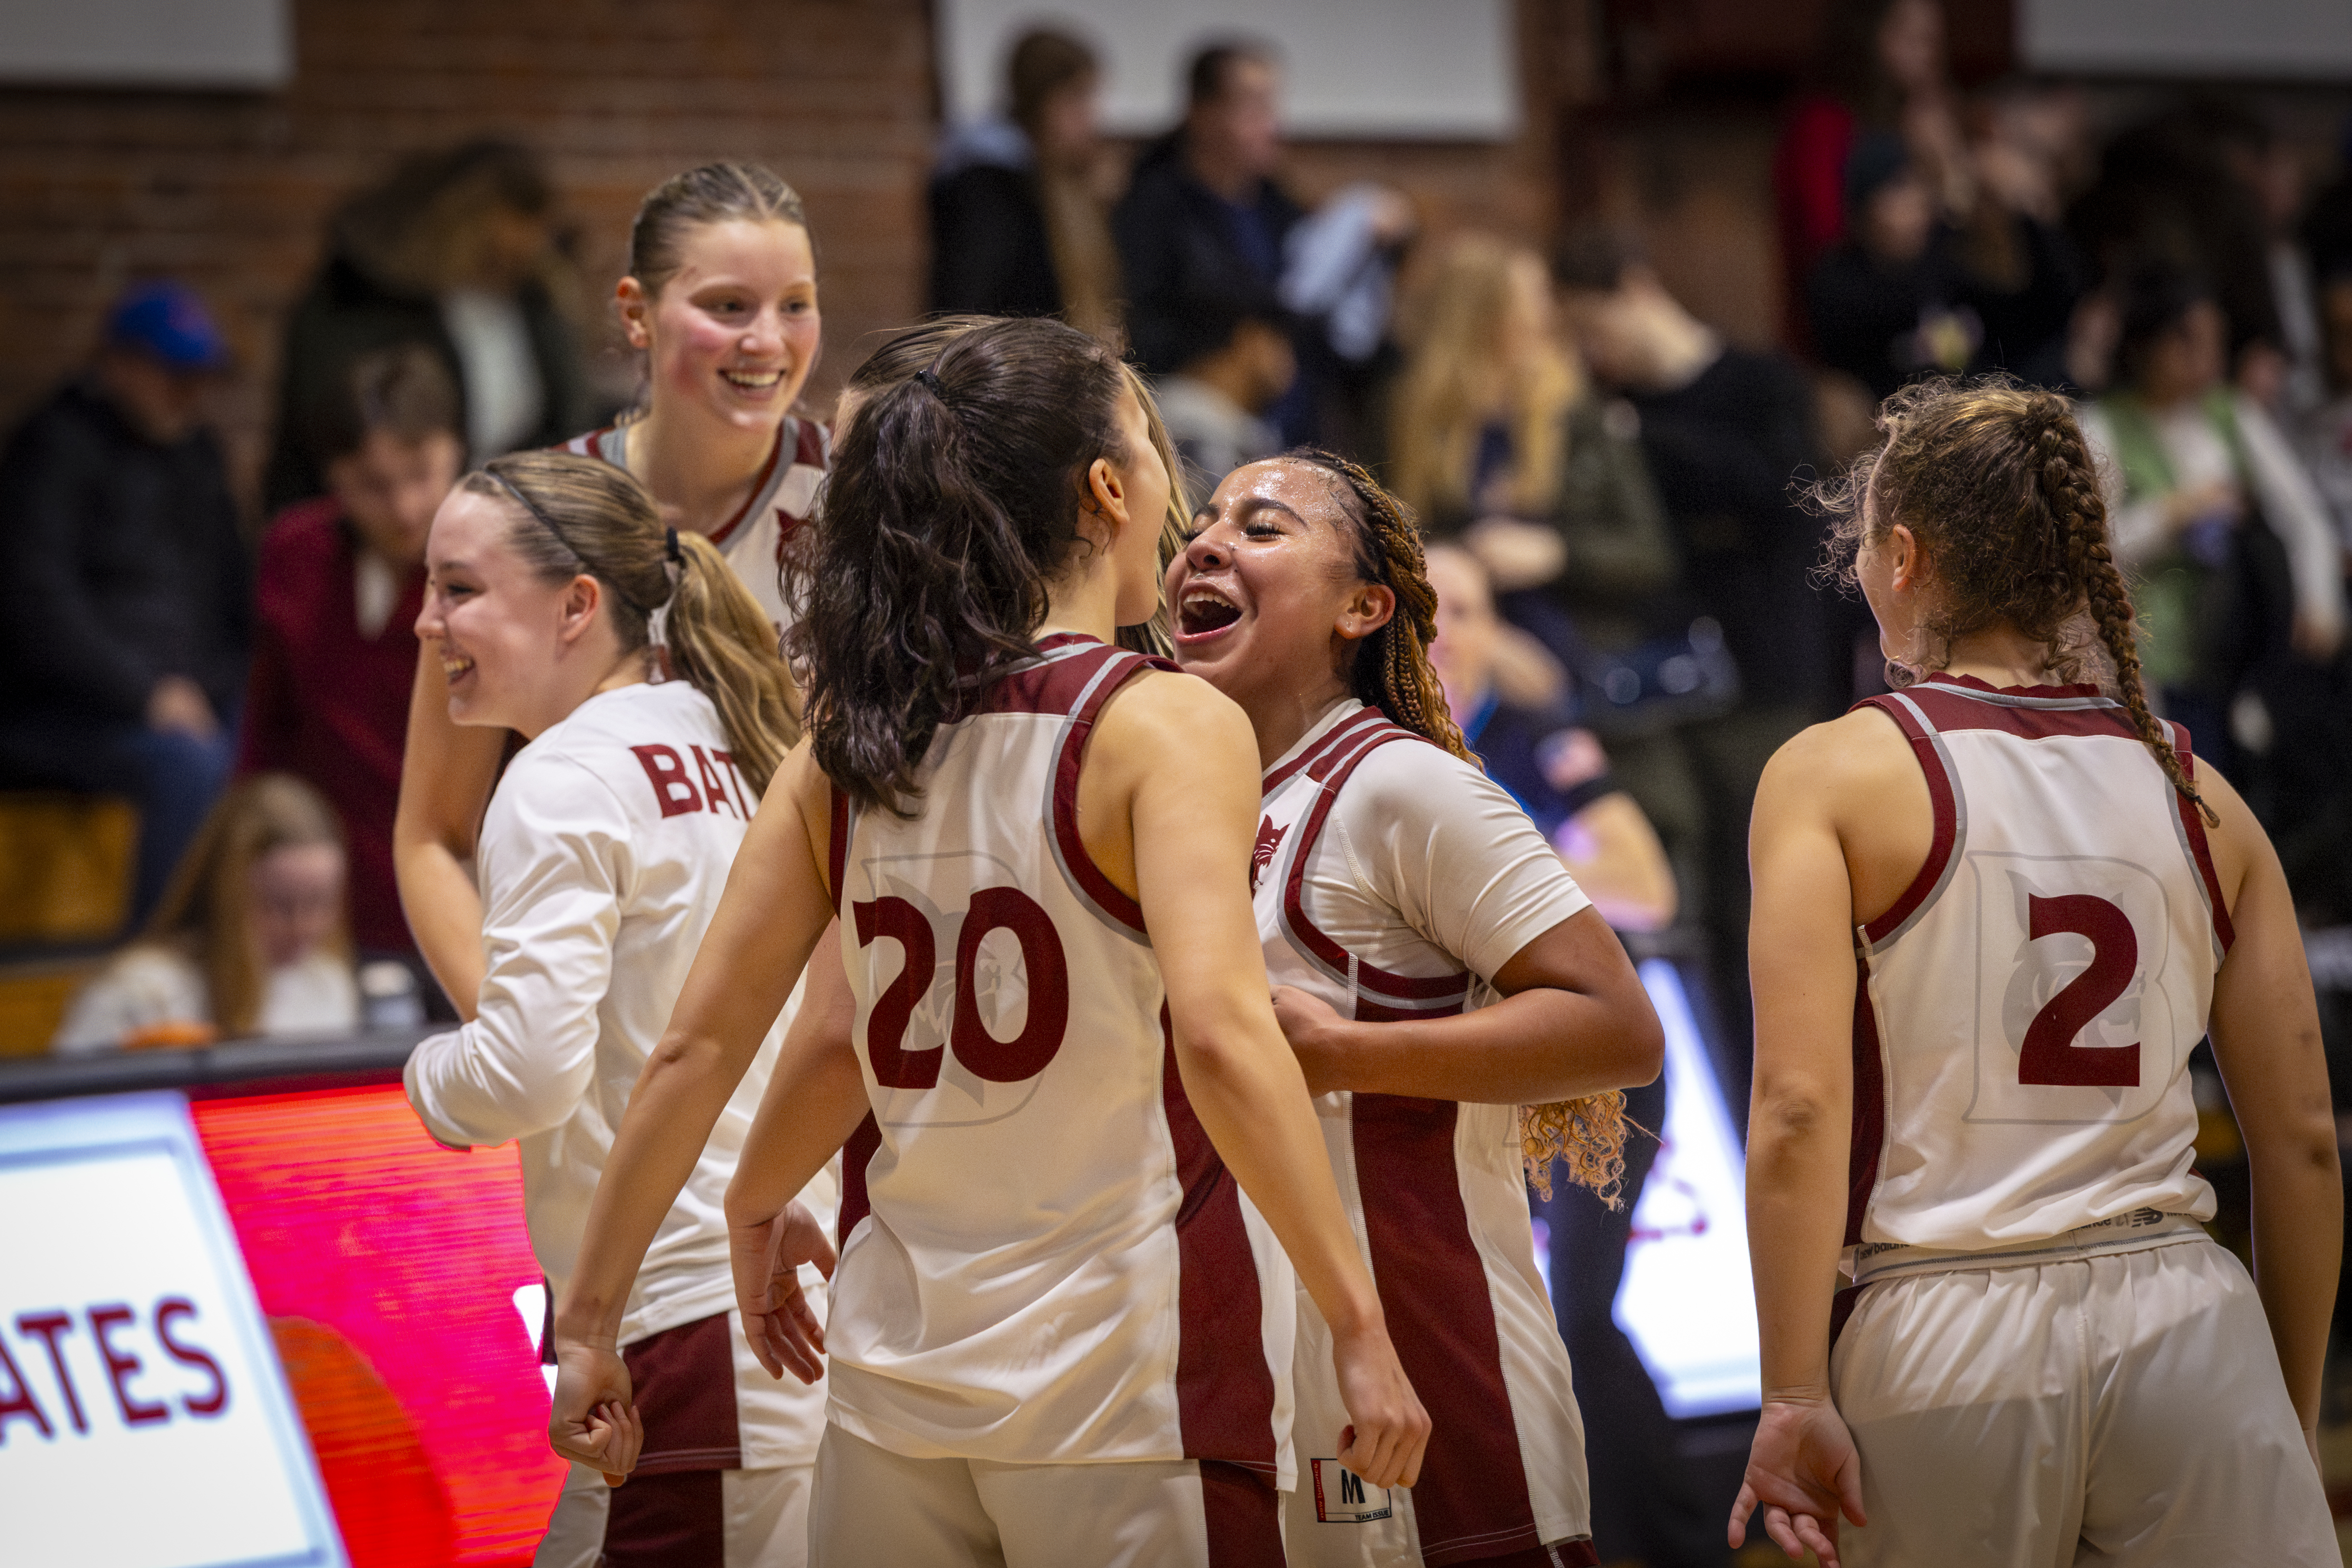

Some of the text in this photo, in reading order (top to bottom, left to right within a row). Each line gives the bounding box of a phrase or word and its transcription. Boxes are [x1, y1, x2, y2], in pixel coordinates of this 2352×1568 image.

[852, 886, 1070, 1089] 20
[2018, 892, 2141, 1087] 2
[1341, 1469, 1366, 1504] M
[1372, 1509, 1389, 1518] ISSUE
